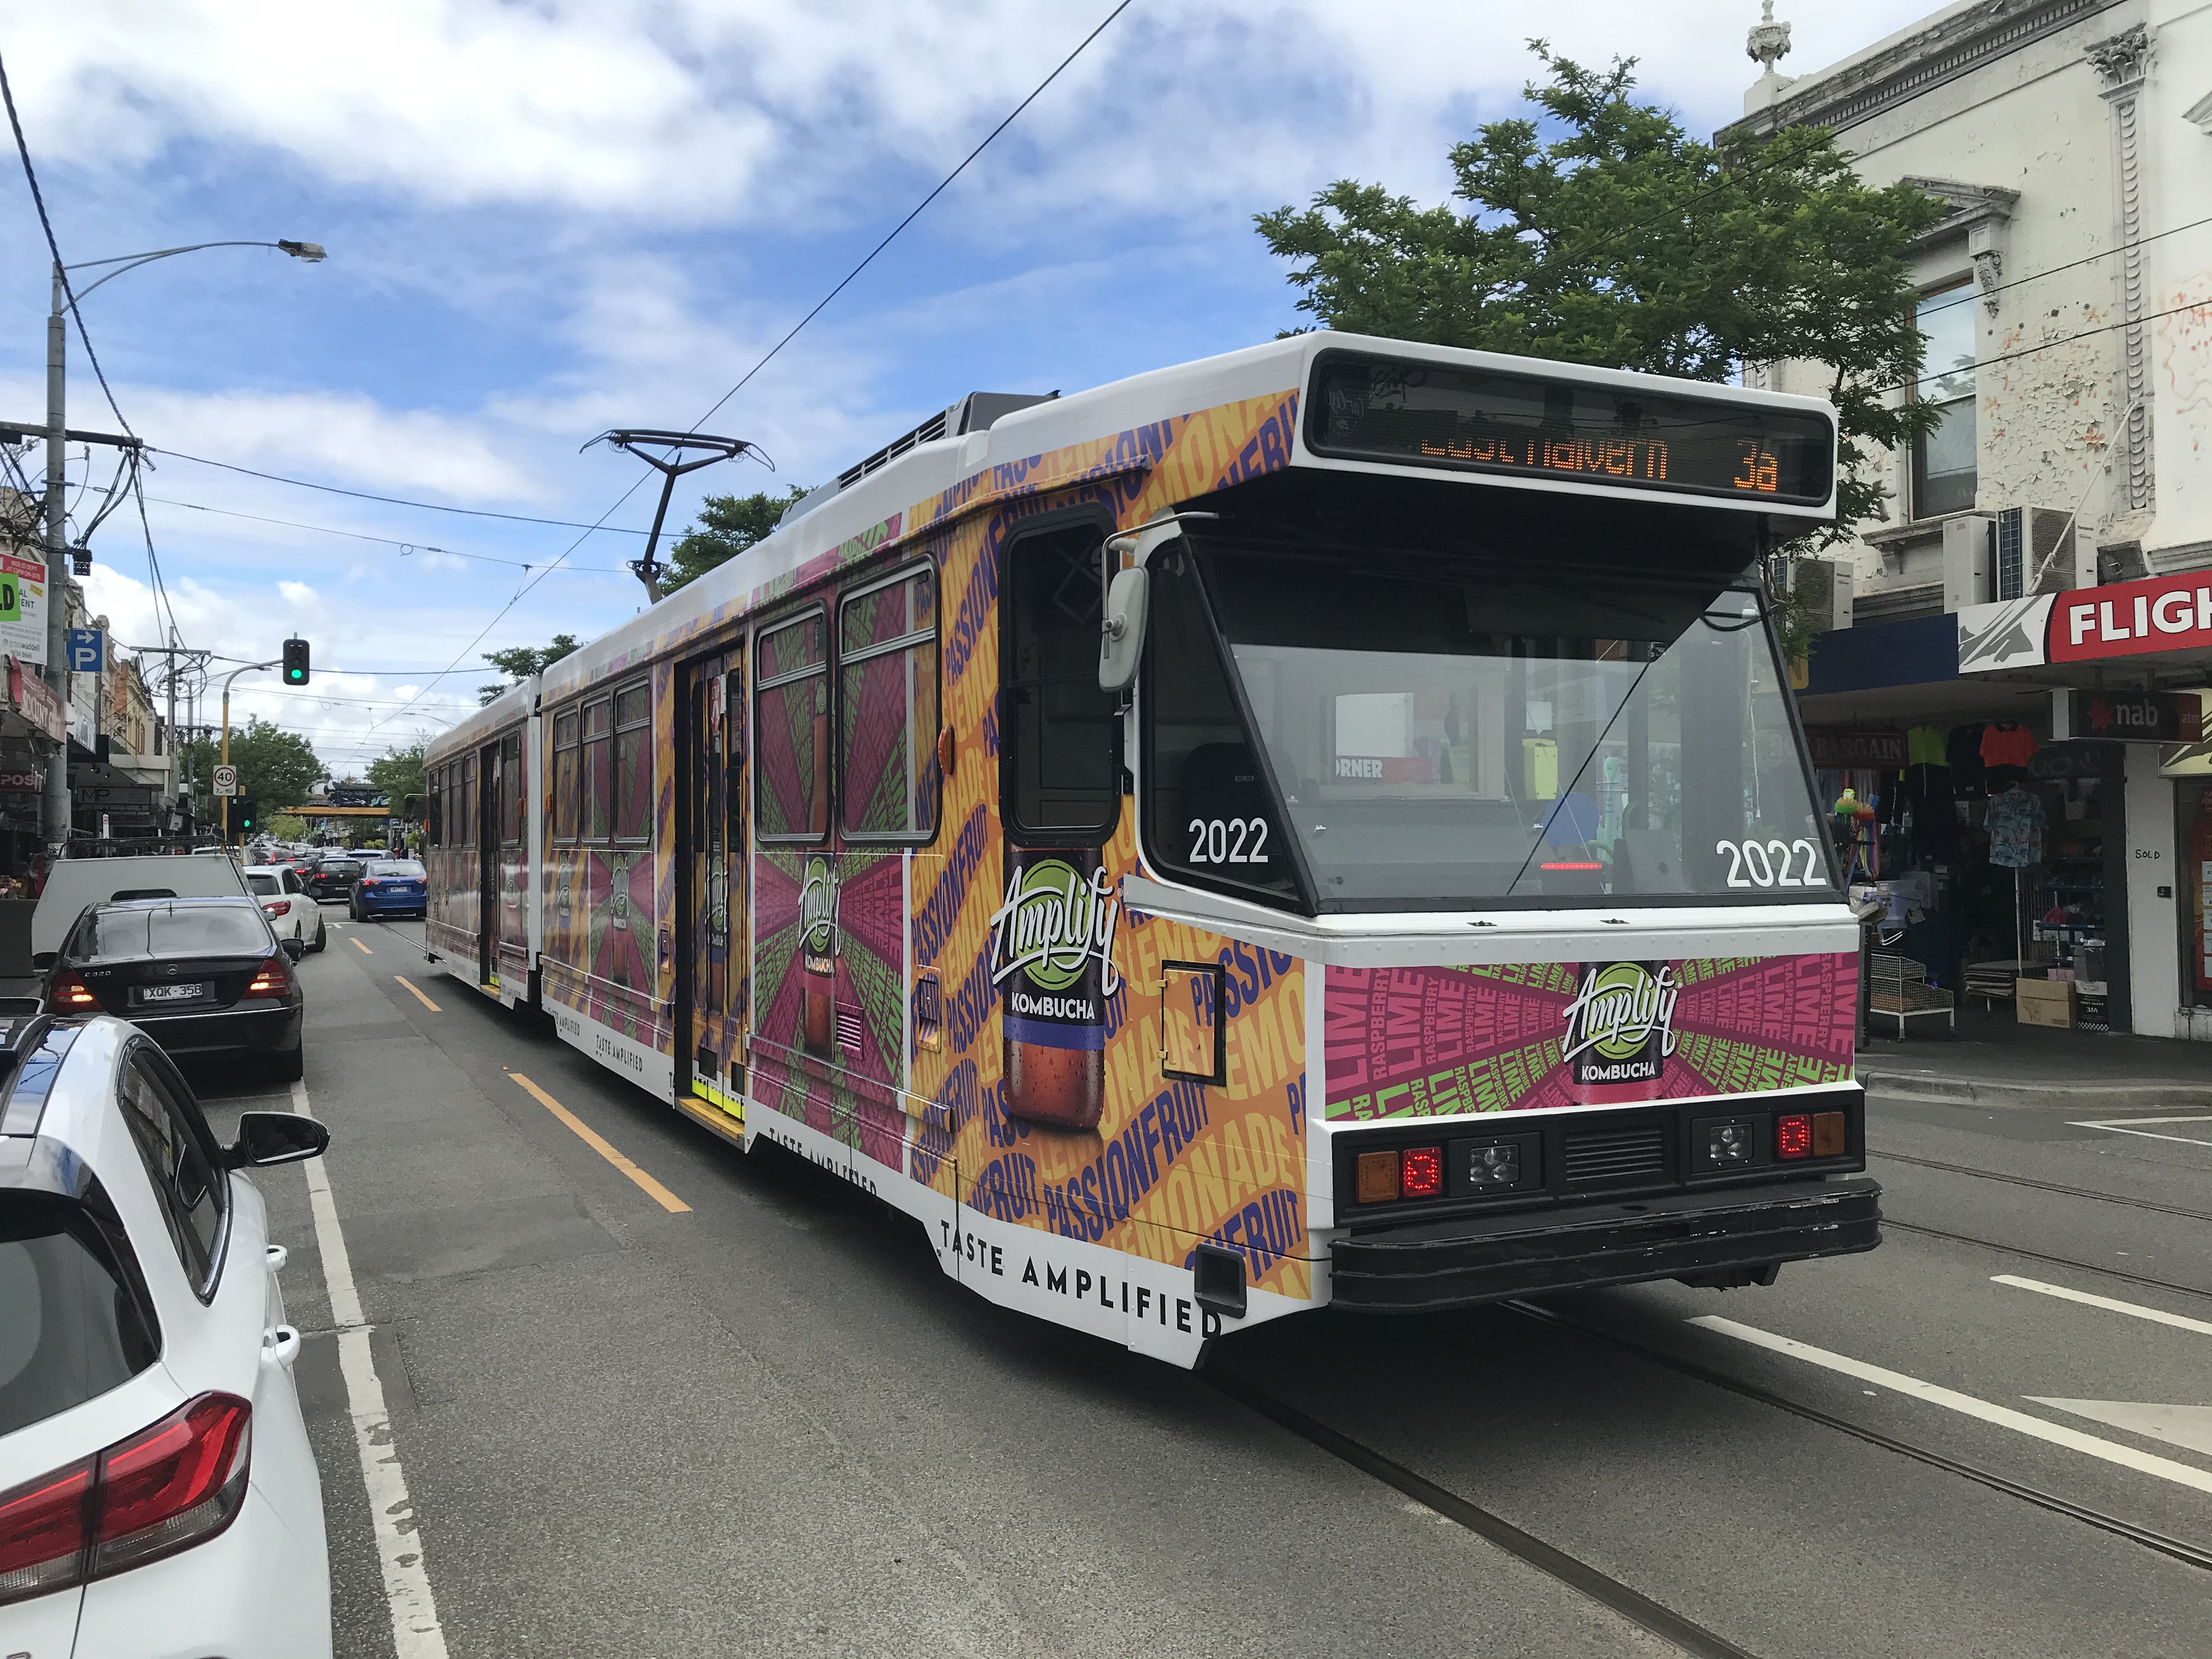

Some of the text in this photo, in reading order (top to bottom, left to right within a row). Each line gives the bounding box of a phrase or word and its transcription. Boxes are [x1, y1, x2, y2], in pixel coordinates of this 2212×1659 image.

[75, 647, 97, 670] P
[2115, 698, 2199, 726] nab atm
[217, 772, 232, 782] 40
[1188, 817, 1268, 864] 2022
[1716, 839, 1827, 888] 2022
[2135, 849, 2160, 860] SOLD
[990, 865, 1119, 997] Amplify
[805, 953, 836, 974] KOMBUCHA
[868, 956, 888, 1040] LIME
[1012, 991, 1095, 1019] KOMBUCHA
[1371, 967, 1391, 1080] RASPBERRY
[1386, 968, 1425, 1077] LIME
[1424, 976, 1439, 1065] RASPBERRY
[1435, 978, 1465, 1063] LIME
[1465, 985, 1477, 1053] RASPBERRY
[1473, 986, 1497, 1051] LIME
[1503, 992, 1521, 1041] LIME
[1562, 966, 1678, 1063] Amplify
[1736, 974, 1756, 1034] LIME
[1760, 964, 1784, 1041] LIME
[1781, 962, 1795, 1042] RASPBERRY
[1791, 953, 1822, 1048] LIME
[1816, 953, 1832, 1049] RASPBERRY
[596, 1034, 643, 1072] TASTE AMPLIFIED
[1499, 1050, 1526, 1103] LIME
[1523, 1043, 1544, 1084] LIME
[1543, 1037, 1559, 1069] LIME
[1581, 1061, 1656, 1081] KOMBUCHA
[1688, 1034, 1711, 1072] LIME
[1701, 1036, 1719, 1078] RASPBERRY
[1706, 1037, 1732, 1087] LIME
[1717, 1041, 1741, 1094] RASPBERRY
[1488, 1056, 1511, 1110] RASPBERRY
[1043, 1080, 1209, 1243] PASSIONFRUIT
[940, 1218, 1003, 1277] TASTE
[1022, 1255, 1222, 1340] AMPLIFIED
